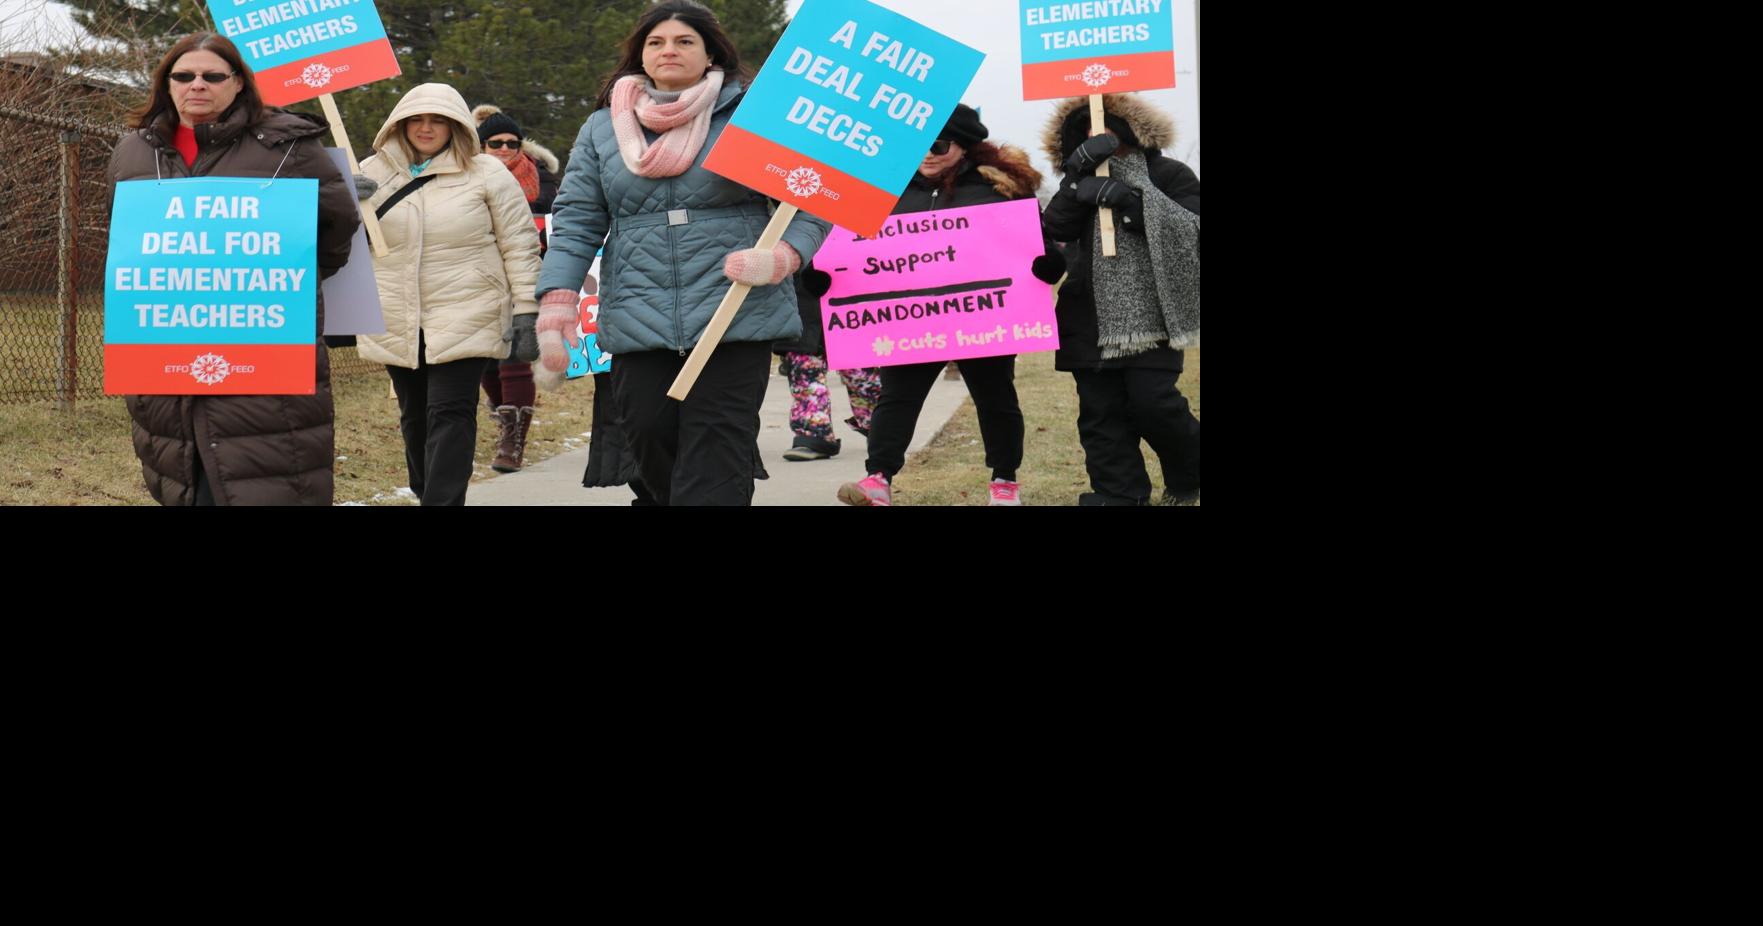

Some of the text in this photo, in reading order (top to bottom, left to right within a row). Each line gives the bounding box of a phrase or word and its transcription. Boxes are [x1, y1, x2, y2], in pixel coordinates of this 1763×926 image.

[222, 0, 359, 38] ELEMENTA
[1026, 0, 1162, 26] ELEMENTARY
[245, 15, 358, 59] TEACHERS
[1041, 23, 1150, 50] TEACHERS
[830, 20, 935, 82] A FAIR
[784, 47, 934, 130] DEAL FOR
[765, 163, 840, 201] ETFO FEEO
[165, 196, 259, 219] A FAIR
[852, 215, 969, 241] clusion
[142, 232, 281, 255] DEAL FOR
[863, 246, 956, 275] Support
[115, 268, 306, 292] ELEMENTARY
[134, 304, 285, 328] TEACHERS
[828, 290, 1007, 331] ABANDONMENT
[956, 325, 1007, 347] hurt
[1013, 322, 1053, 341] kids
[165, 365, 255, 373] ETFO FEEO
